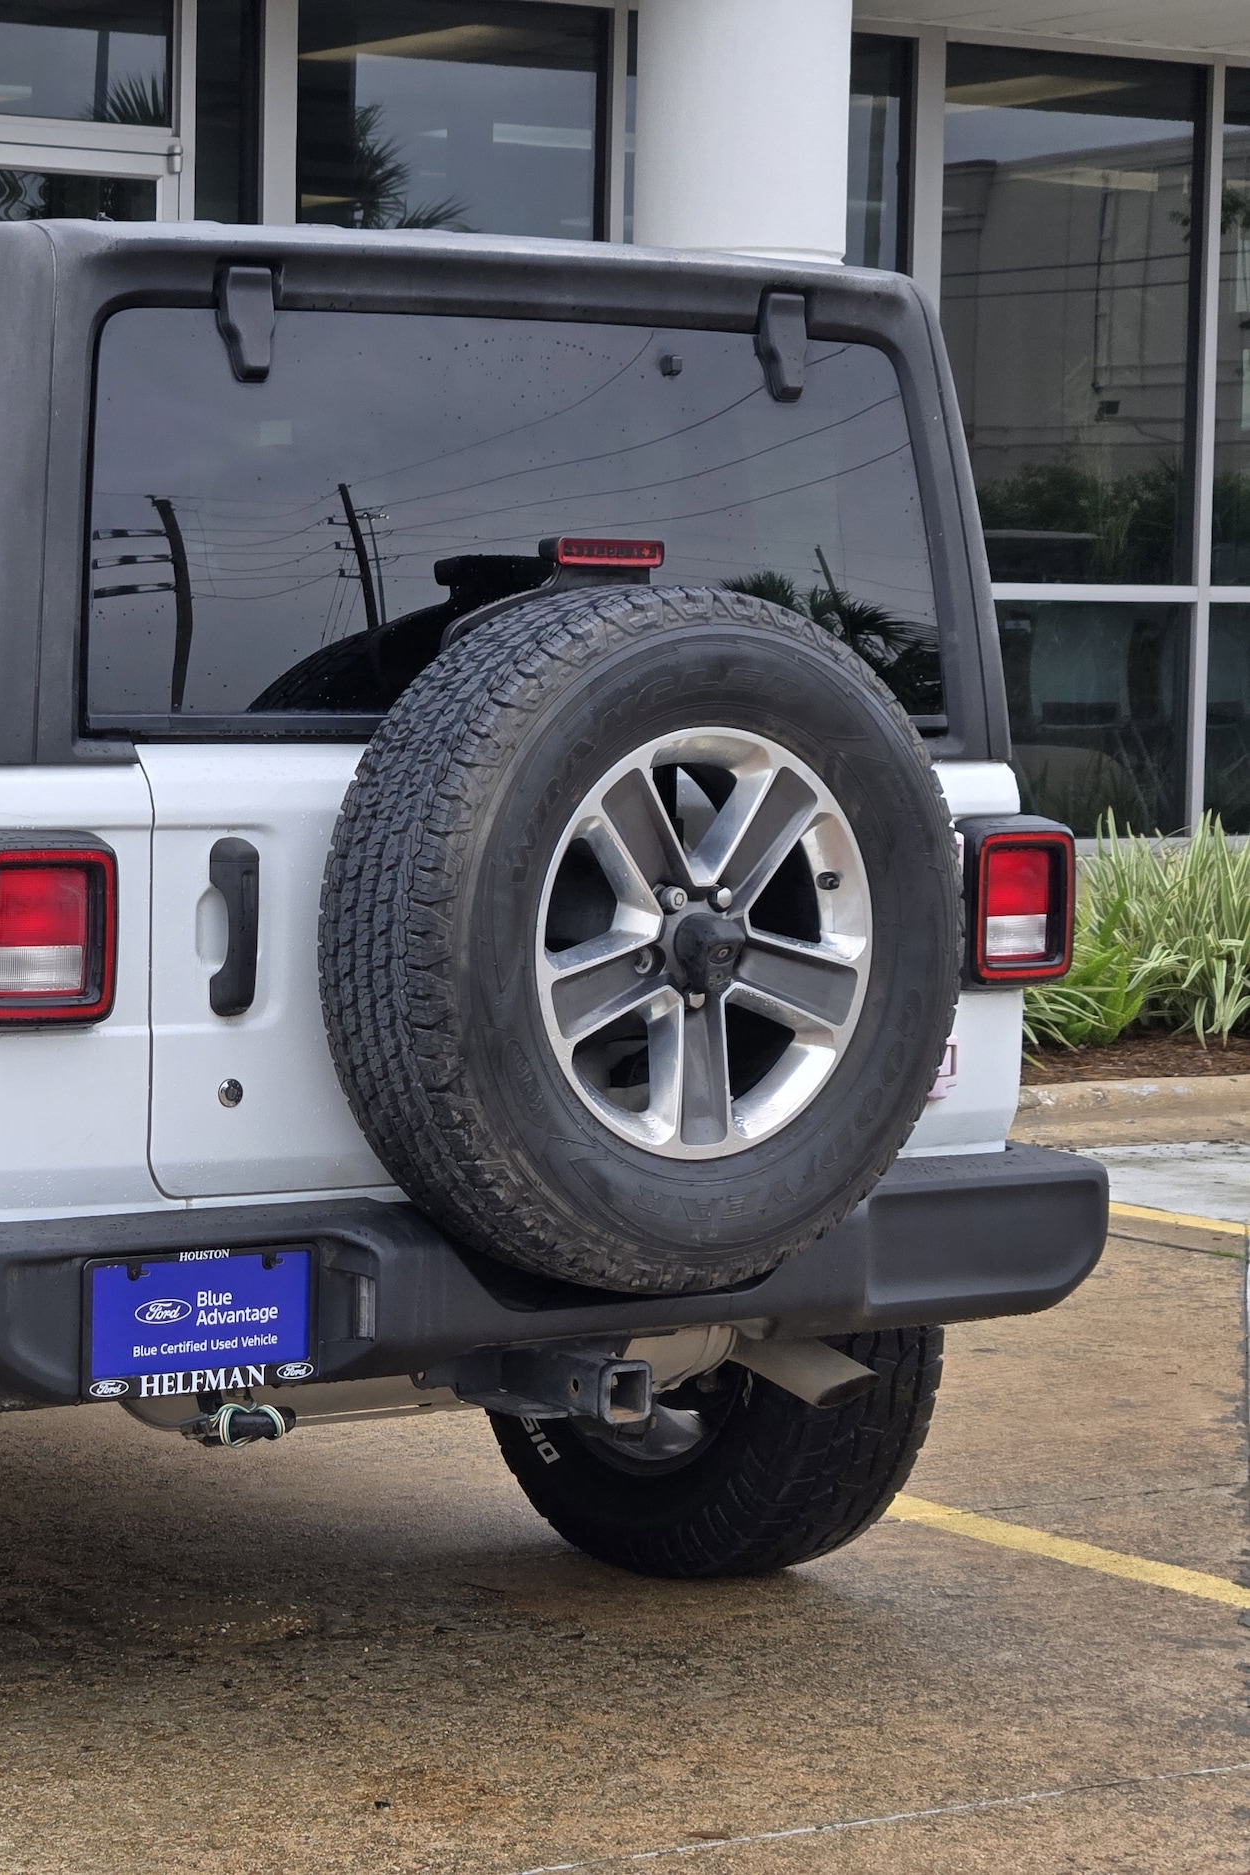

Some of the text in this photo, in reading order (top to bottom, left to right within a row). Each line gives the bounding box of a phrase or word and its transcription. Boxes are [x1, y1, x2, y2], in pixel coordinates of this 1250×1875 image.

[179, 1248, 230, 1262] HOUSTON
[196, 1290, 232, 1308] Blue
[145, 1301, 181, 1321] Ford
[196, 1305, 279, 1326] Advantage
[133, 1333, 278, 1358] Blue Certified Used Vehicle
[97, 1363, 308, 1398] Ford HELFMAN Ford
